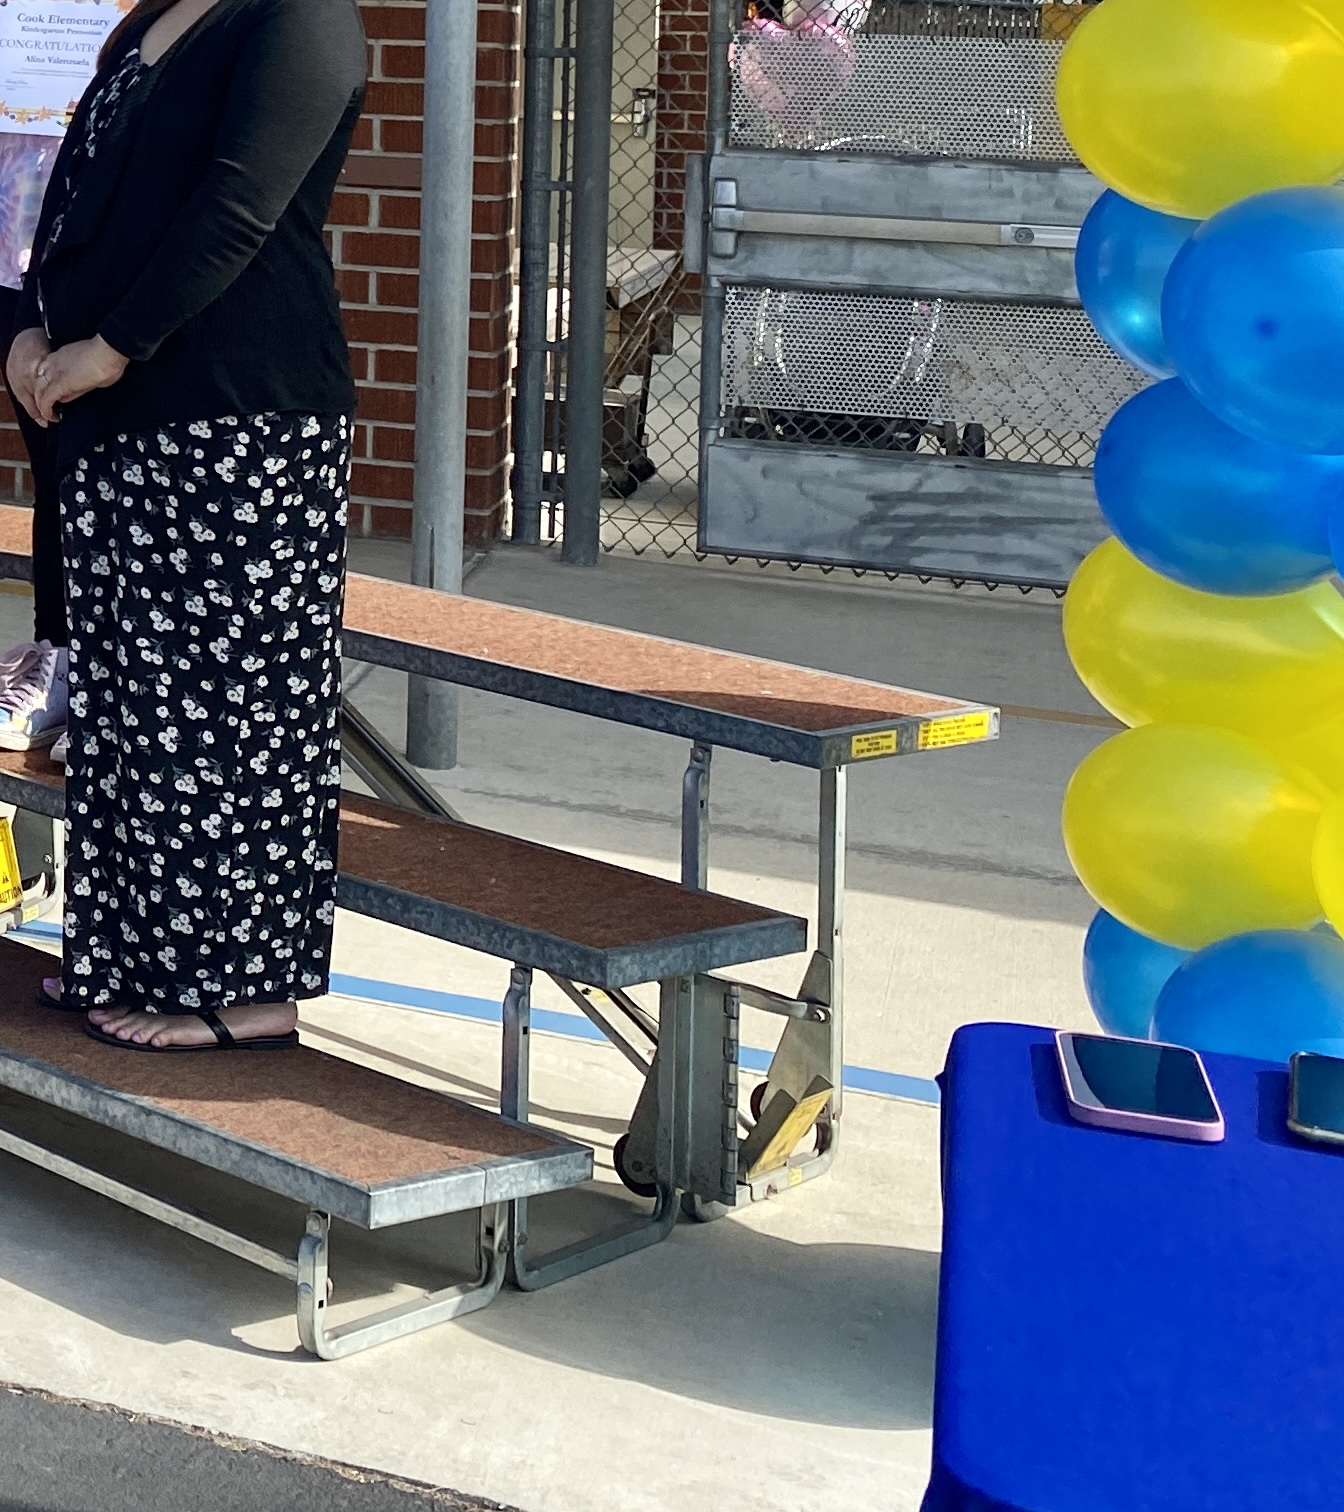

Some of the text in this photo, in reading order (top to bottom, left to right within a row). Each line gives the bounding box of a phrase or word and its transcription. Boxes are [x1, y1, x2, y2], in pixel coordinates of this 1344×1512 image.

[17, 12, 110, 28] Cook Elementary
[21, 26, 65, 35] Kindergarten
[25, 55, 89, 66] Alina Valenzuela
